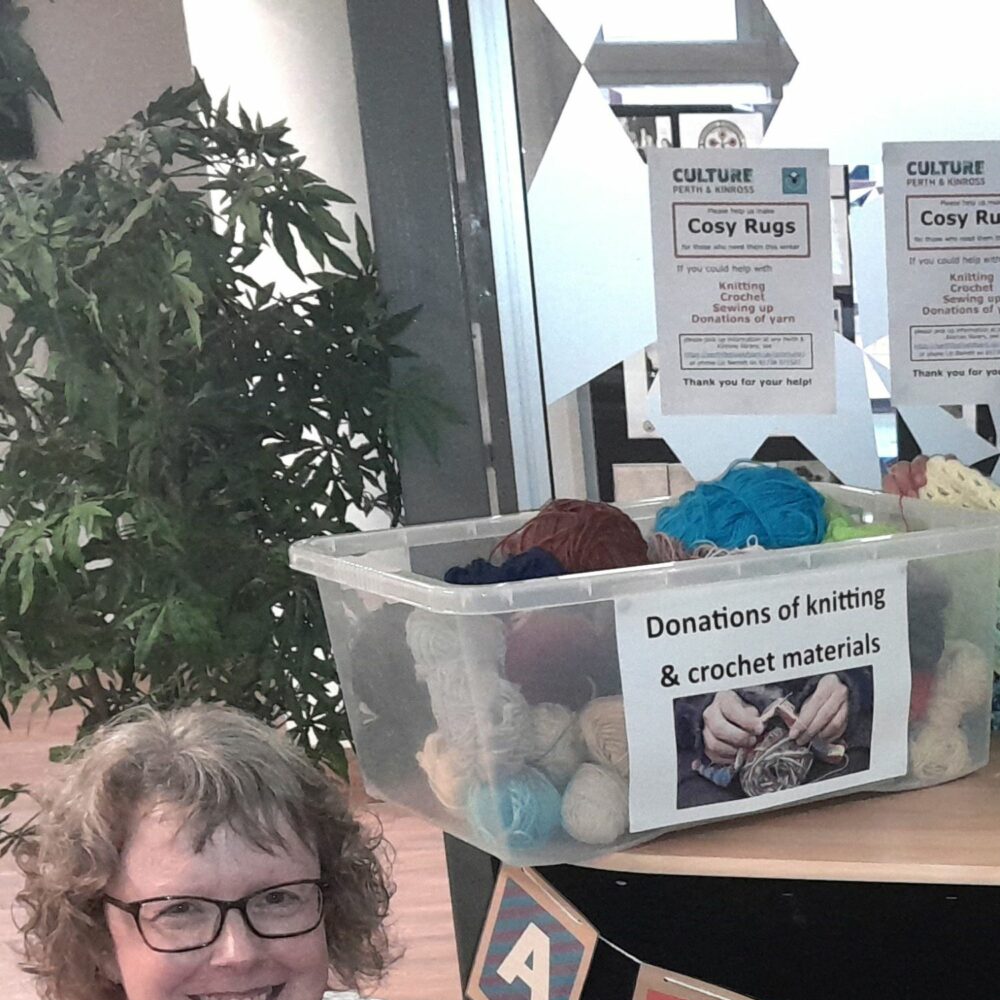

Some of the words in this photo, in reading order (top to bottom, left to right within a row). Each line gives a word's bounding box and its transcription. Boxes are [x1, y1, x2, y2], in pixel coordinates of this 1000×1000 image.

[907, 161, 985, 176] CULTURE
[673, 168, 753, 183] CULTURE
[907, 178, 936, 187] PERTH
[939, 178, 944, 186] &
[948, 177, 985, 186] KINROSS
[673, 186, 703, 194] PERTH
[706, 186, 712, 194] &
[715, 186, 755, 194] KINROSS
[921, 210, 968, 229] Cosy
[688, 218, 737, 237] Cosy
[745, 218, 796, 237] Rugs
[909, 257, 916, 265] If
[919, 258, 934, 266] you
[937, 257, 960, 265] could
[963, 256, 981, 265] help
[984, 256, 1000, 264] with
[687, 266, 702, 274] you
[706, 264, 729, 272] could
[732, 265, 751, 274] help
[950, 273, 994, 283] Knitting
[718, 282, 766, 292] Knitting
[950, 284, 993, 293] Crochet
[720, 292, 765, 301] Crochet
[943, 295, 984, 305] Sewing
[712, 303, 755, 314] Sewing
[759, 305, 774, 314] up
[922, 306, 979, 315] Donations
[982, 305, 994, 314] of
[692, 314, 750, 323] Donations
[754, 314, 766, 323] of
[769, 316, 796, 325] yarn
[912, 369, 943, 377] Thank
[946, 370, 965, 378] you
[968, 368, 983, 377] for
[683, 378, 715, 386] Thank
[718, 379, 738, 387] you
[741, 378, 756, 386] for
[759, 379, 783, 387] your
[786, 378, 812, 387] help!
[646, 606, 771, 639] Donations
[778, 596, 800, 621] of
[806, 586, 886, 617] knitting
[660, 664, 680, 688] &
[687, 652, 776, 684] crochet
[782, 632, 881, 668] materials
